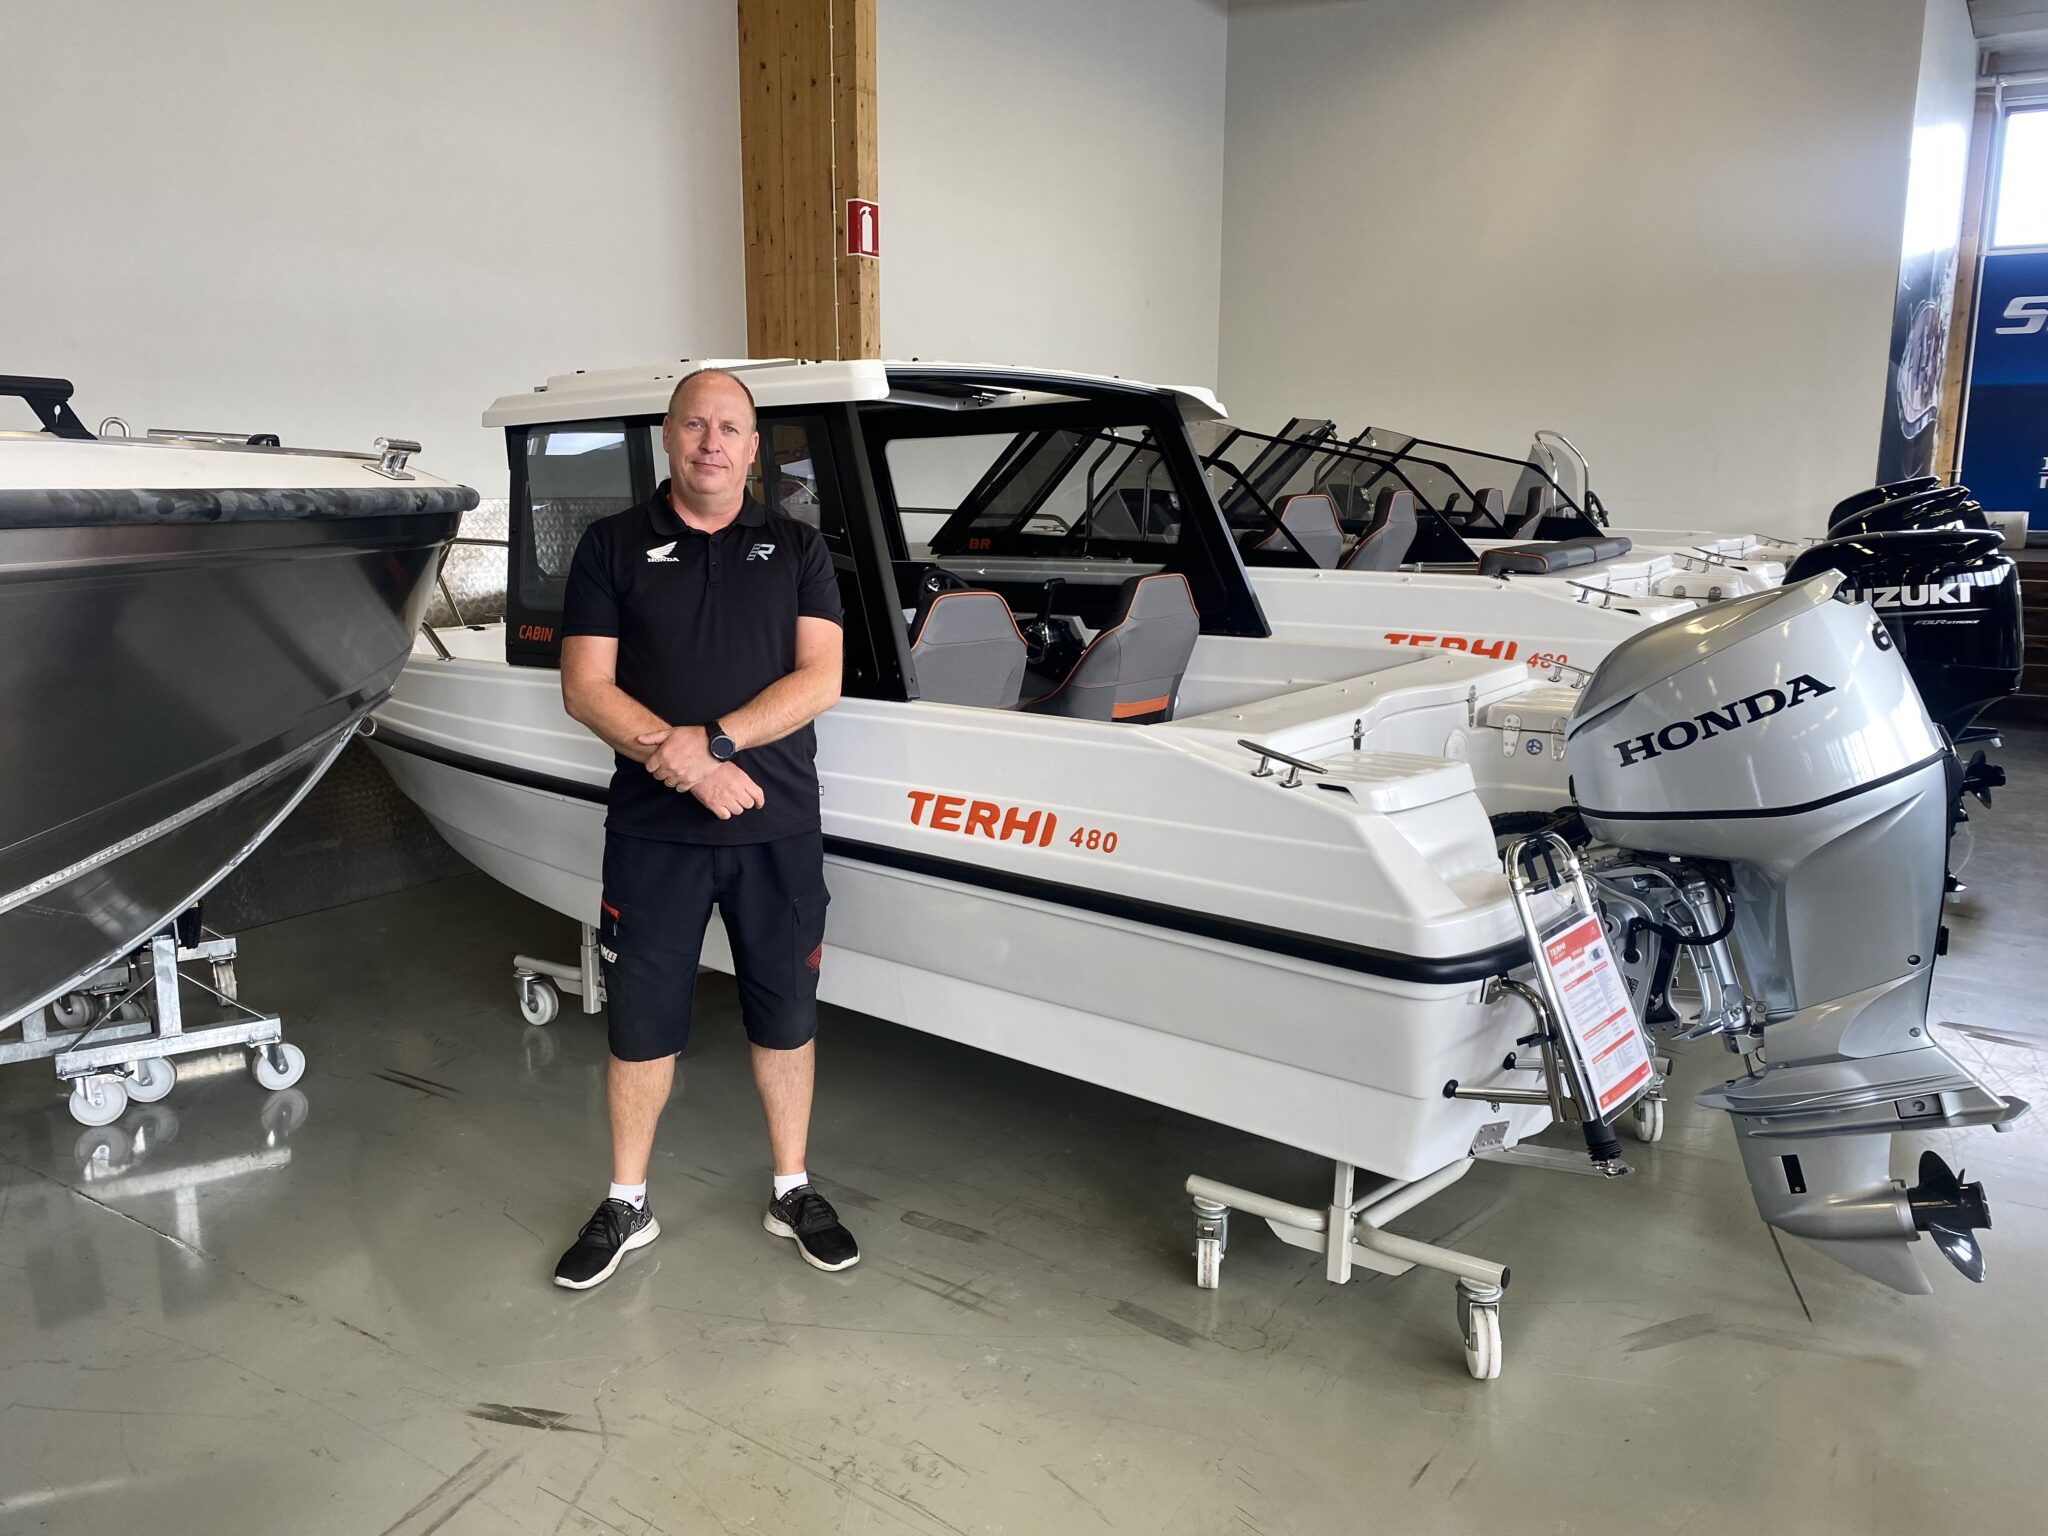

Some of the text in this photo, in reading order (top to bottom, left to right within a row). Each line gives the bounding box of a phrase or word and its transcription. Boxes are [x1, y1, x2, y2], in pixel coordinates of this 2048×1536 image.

[969, 538, 991, 550] BR
[519, 624, 554, 643] CABIN
[1613, 674, 1837, 768] HONDA
[907, 790, 1119, 854] TERHI 480
